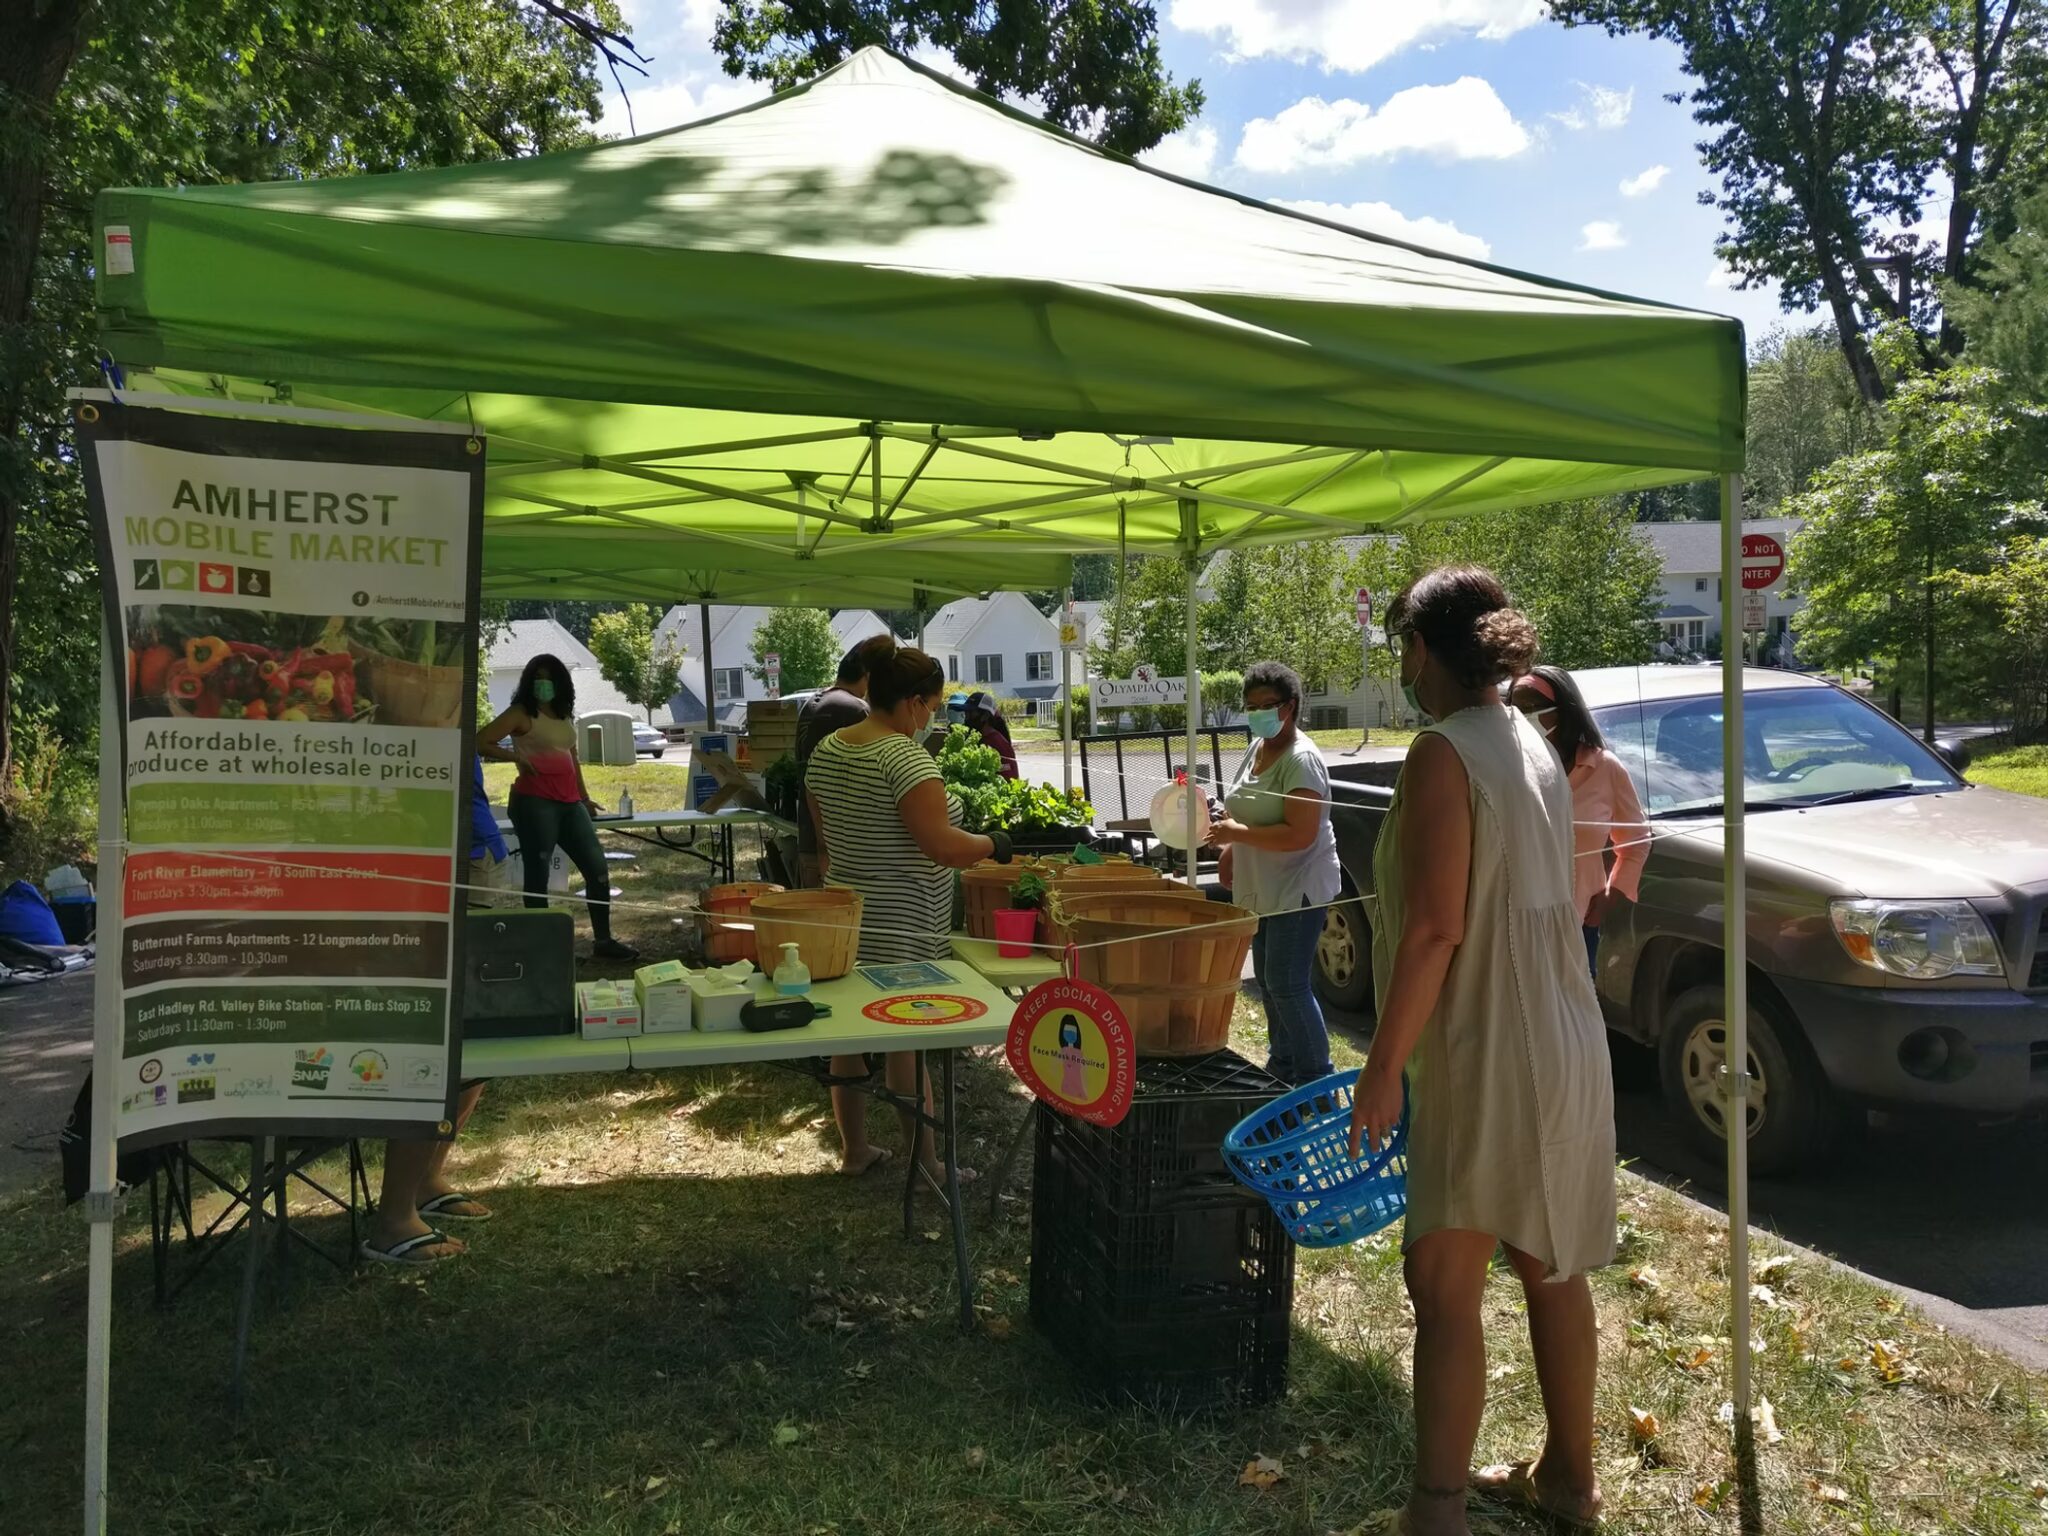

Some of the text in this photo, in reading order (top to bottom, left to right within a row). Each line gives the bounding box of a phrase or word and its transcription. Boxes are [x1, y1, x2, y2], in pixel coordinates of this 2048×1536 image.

[172, 479, 398, 526] AMHERST
[124, 516, 449, 567] MOBILE MARKET
[1755, 544, 1776, 554] NOT
[1742, 569, 1771, 579] NTER
[1099, 680, 1186, 696] OLYMPIA OAK
[144, 730, 416, 758] Affordable, fresh local
[128, 753, 450, 781] produce at wholesale prices
[181, 797, 210, 811] Oaks
[214, 797, 279, 813] Apartments
[132, 869, 151, 881] Fort
[155, 867, 186, 879] River
[191, 866, 255, 881] Elementary
[268, 867, 281, 878] 70
[284, 867, 316, 878] South
[319, 868, 342, 878] East
[132, 884, 184, 900] Thursdays
[132, 935, 183, 952] Butternut
[186, 933, 223, 946] Farms
[226, 933, 291, 946] Apartments
[303, 933, 316, 945] 12
[319, 934, 390, 948] Longmeadow
[393, 934, 421, 945] Drive
[133, 955, 182, 973] Saturdays
[185, 952, 228, 965] 8:30am
[138, 1009, 156, 1023] East
[158, 1001, 195, 1017] Hadley
[199, 1000, 217, 1012] Rd.
[221, 1000, 254, 1013] Valley
[258, 1000, 282, 1011] Bike
[285, 999, 323, 1011] Station
[335, 999, 362, 1011] PVTA
[364, 1000, 384, 1011] Bus
[387, 1000, 411, 1013] Stop
[414, 1000, 432, 1012] 152
[137, 1023, 181, 1042] Saturdays
[186, 1018, 234, 1032] 11:30am
[247, 1018, 287, 1032] 1:30pm
[1024, 992, 1048, 1022] KEEP
[1054, 986, 1098, 1010] SOCIAL
[1101, 1010, 1129, 1106] DISTANCING
[1033, 1046, 1105, 1069] Face Mask Required
[293, 1069, 329, 1082] SNAP
